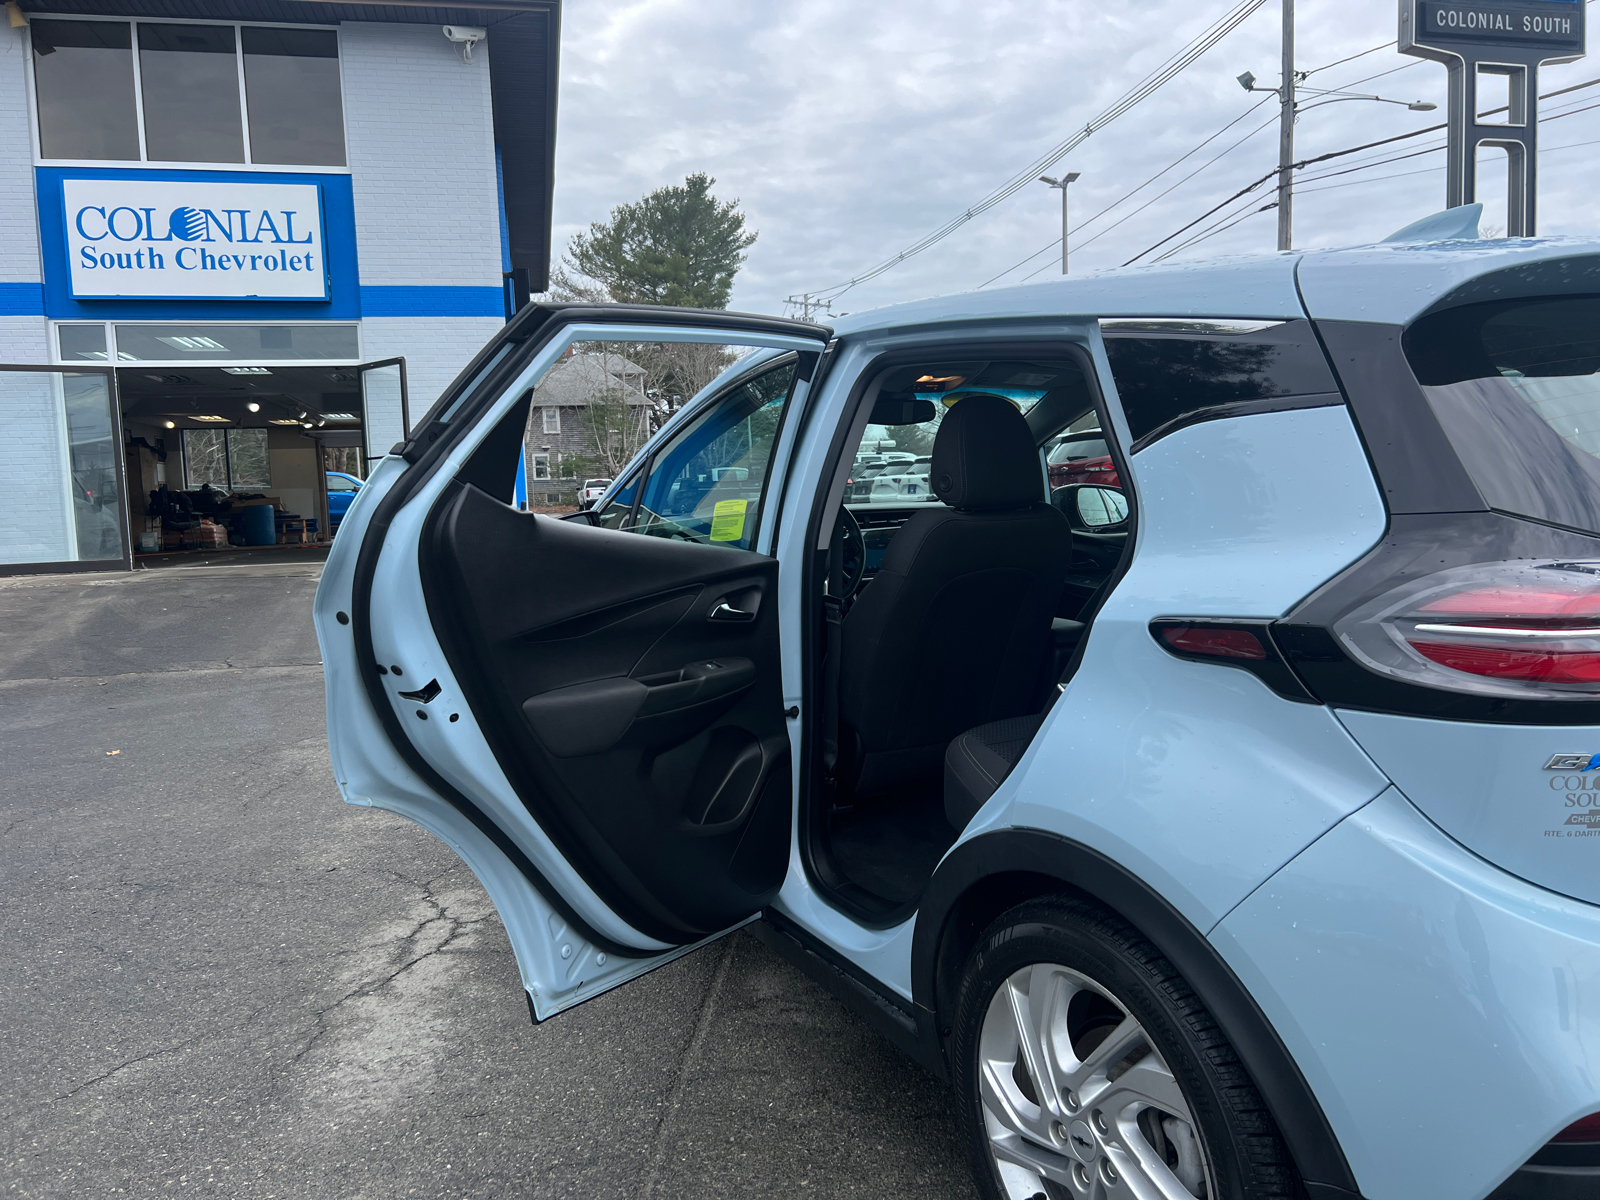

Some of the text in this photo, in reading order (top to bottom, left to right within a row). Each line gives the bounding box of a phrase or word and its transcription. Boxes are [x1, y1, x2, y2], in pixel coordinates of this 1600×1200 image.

[1436, 9, 1571, 34] COLONIAL SOUTH
[75, 205, 314, 245] COLONIAL
[80, 245, 315, 272] South Chevrolet
[1127, 981, 1215, 1120] BRIDGESTONE
